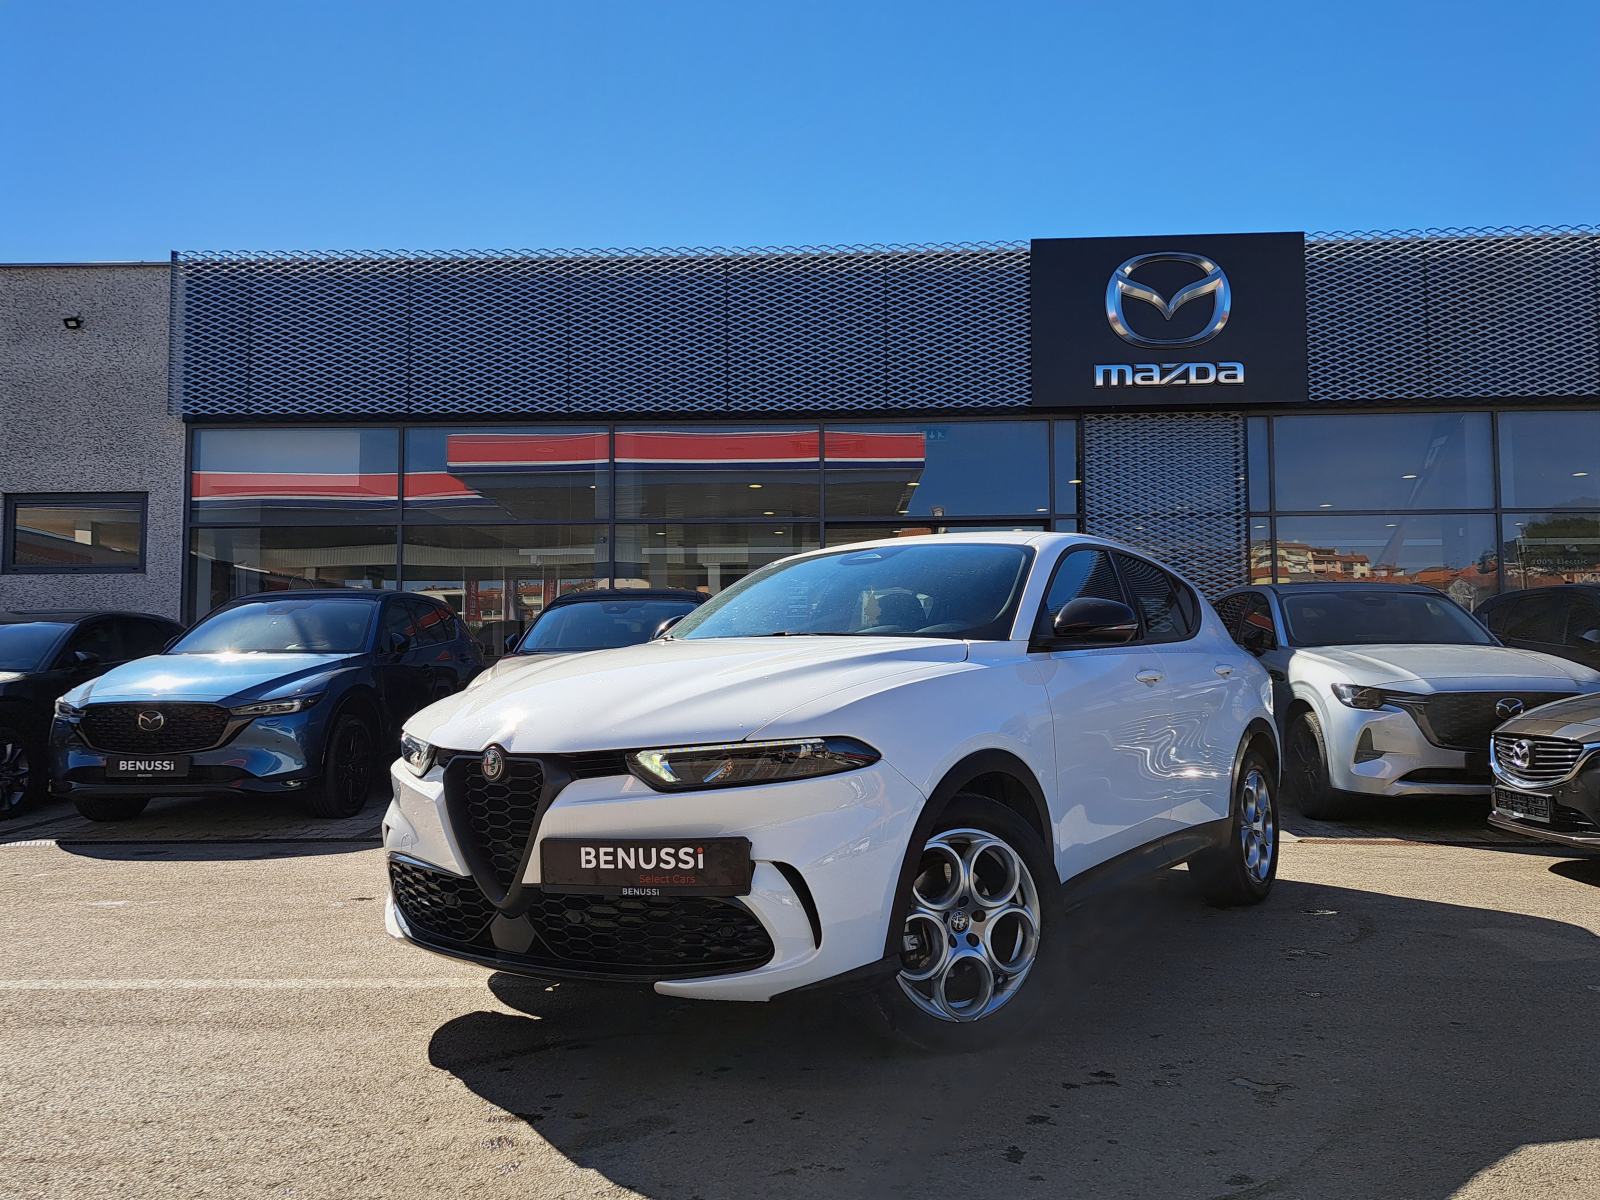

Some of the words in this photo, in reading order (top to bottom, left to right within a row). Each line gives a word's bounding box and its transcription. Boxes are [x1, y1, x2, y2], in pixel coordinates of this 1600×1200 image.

[1094, 361, 1245, 387] mazda
[640, 874, 669, 883] Select
[672, 874, 696, 884] Cars
